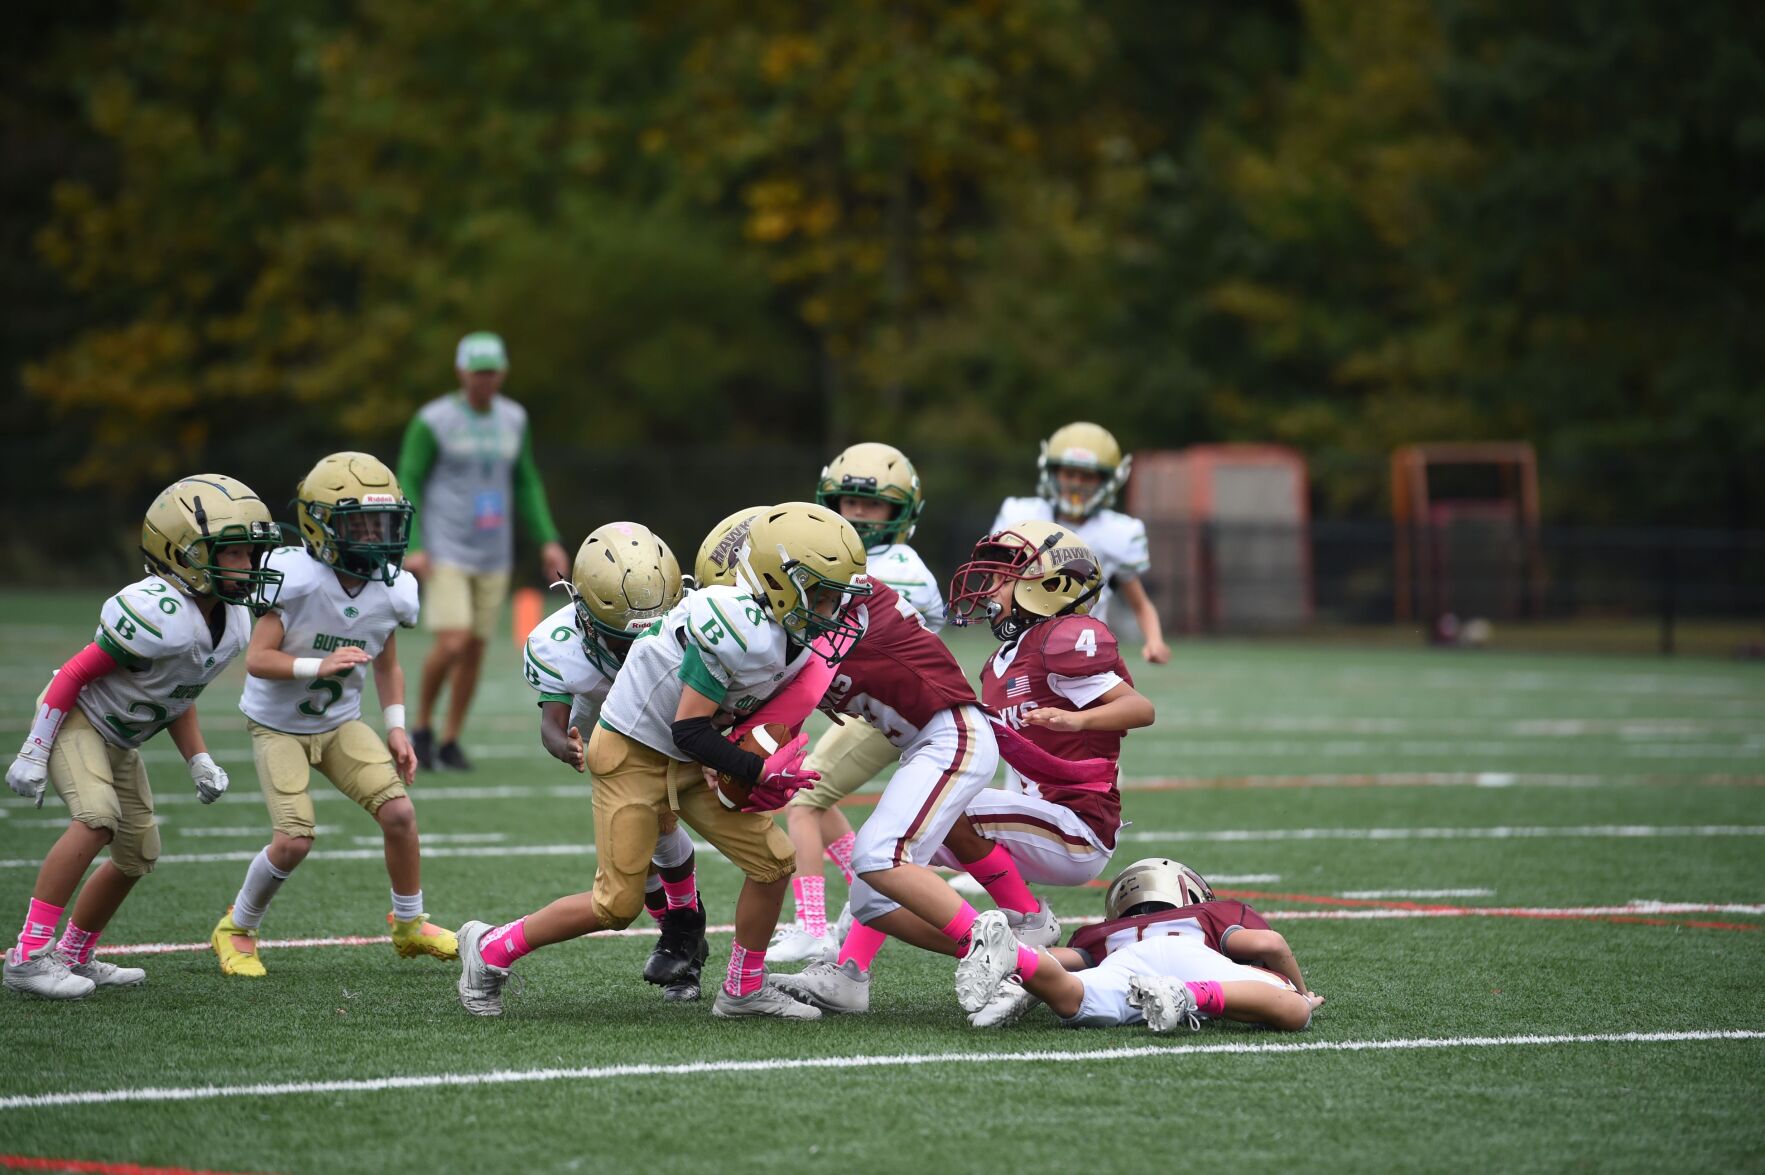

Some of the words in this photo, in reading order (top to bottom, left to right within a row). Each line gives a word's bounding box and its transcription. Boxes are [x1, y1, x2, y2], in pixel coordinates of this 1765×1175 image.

[138, 582, 183, 615] 26
[112, 613, 137, 641] B
[632, 622, 654, 630] Ridd
[699, 616, 725, 646] B
[1074, 629, 1097, 657] 4
[525, 661, 541, 686] B
